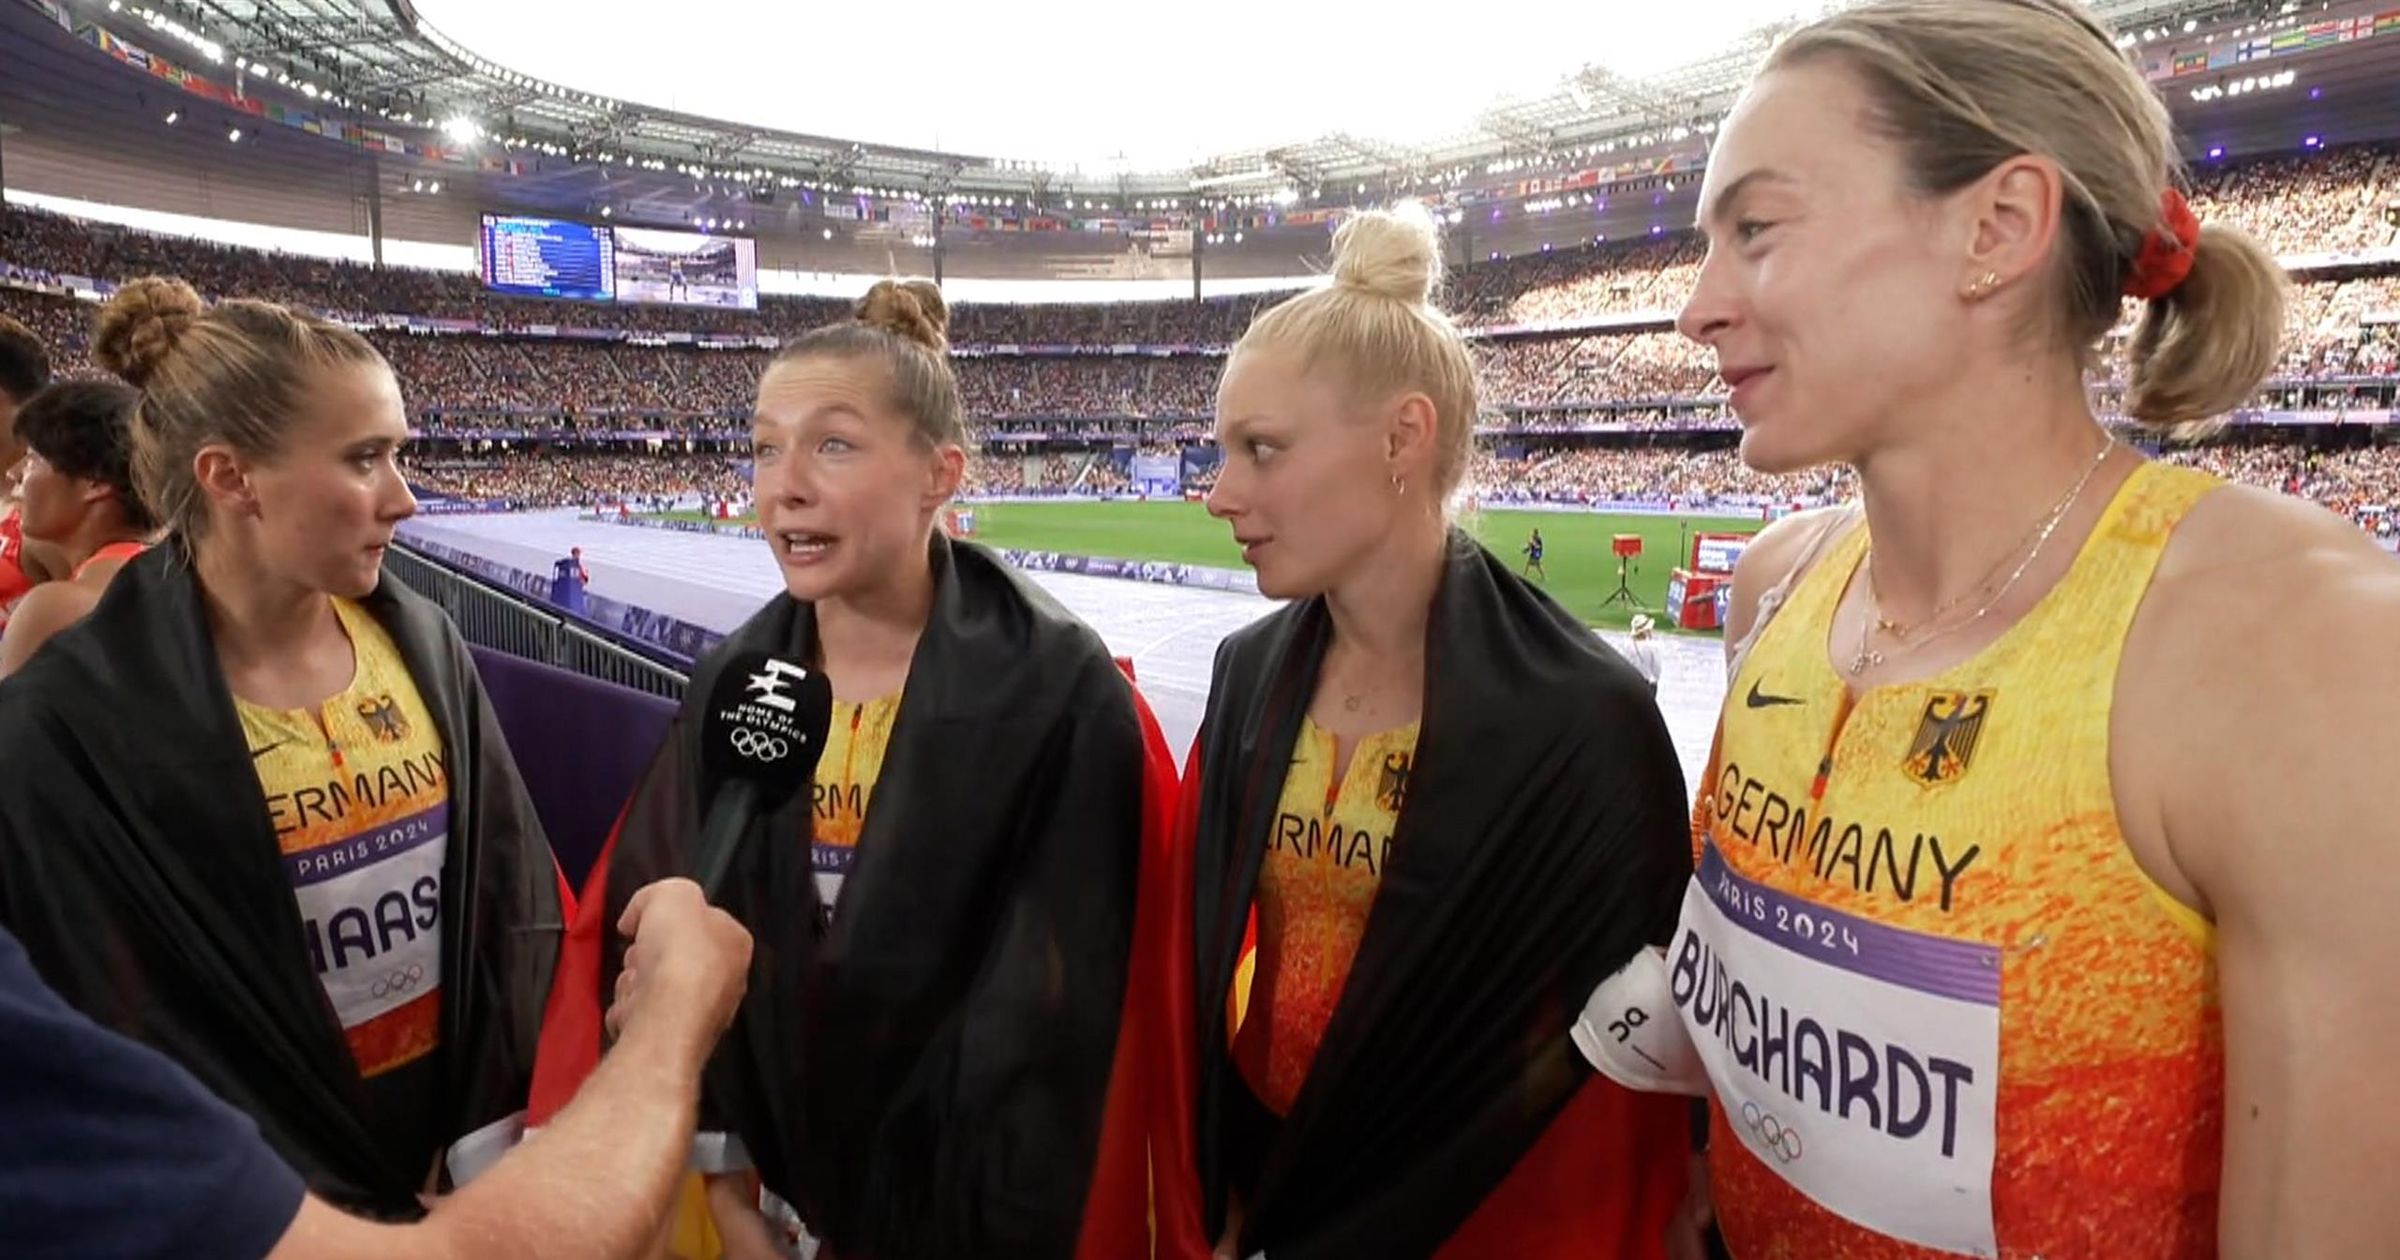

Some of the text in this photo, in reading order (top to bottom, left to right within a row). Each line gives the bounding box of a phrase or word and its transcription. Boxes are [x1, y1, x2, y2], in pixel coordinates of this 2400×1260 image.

[721, 710, 808, 744] THE OLYMPICS
[738, 703, 795, 725] HOME OF
[265, 747, 448, 834] ERMANY
[297, 819, 430, 877] PARIS 2024
[1716, 762, 1981, 912] GERMANY
[1775, 904, 1859, 957] 2024
[1670, 928, 1974, 1158] BURGHARDT
